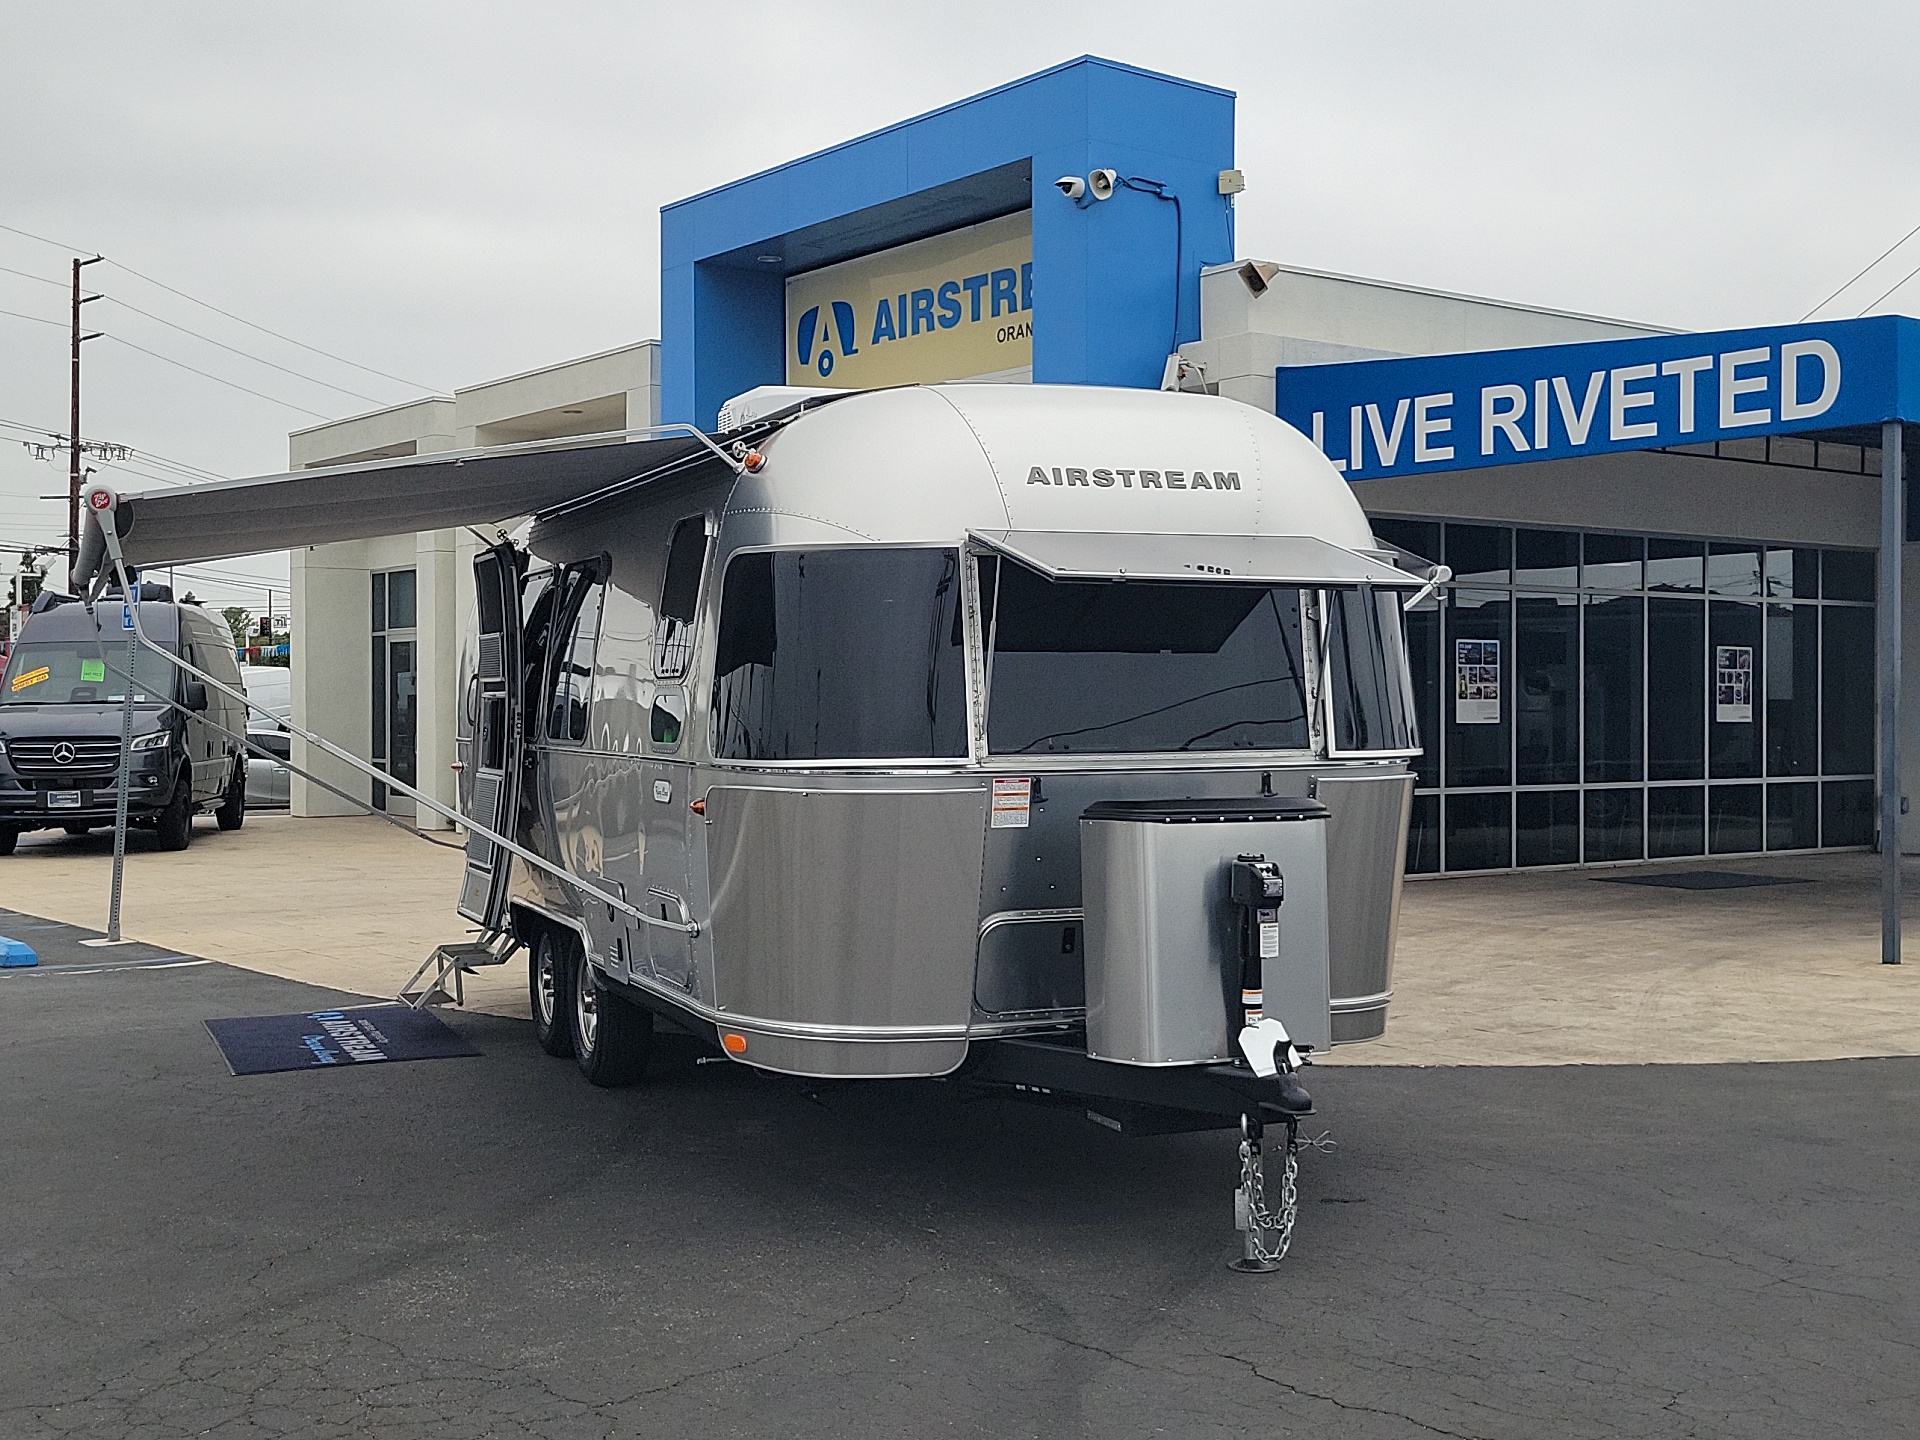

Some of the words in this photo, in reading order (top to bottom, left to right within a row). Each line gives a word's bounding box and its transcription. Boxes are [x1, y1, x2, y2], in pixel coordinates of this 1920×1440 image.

[1312, 393, 1455, 472] LIVE
[1480, 338, 1843, 456] RIVETED
[1026, 466, 1242, 491] AIRSTREAM
[318, 1020, 388, 1061] AIRSTREAM
